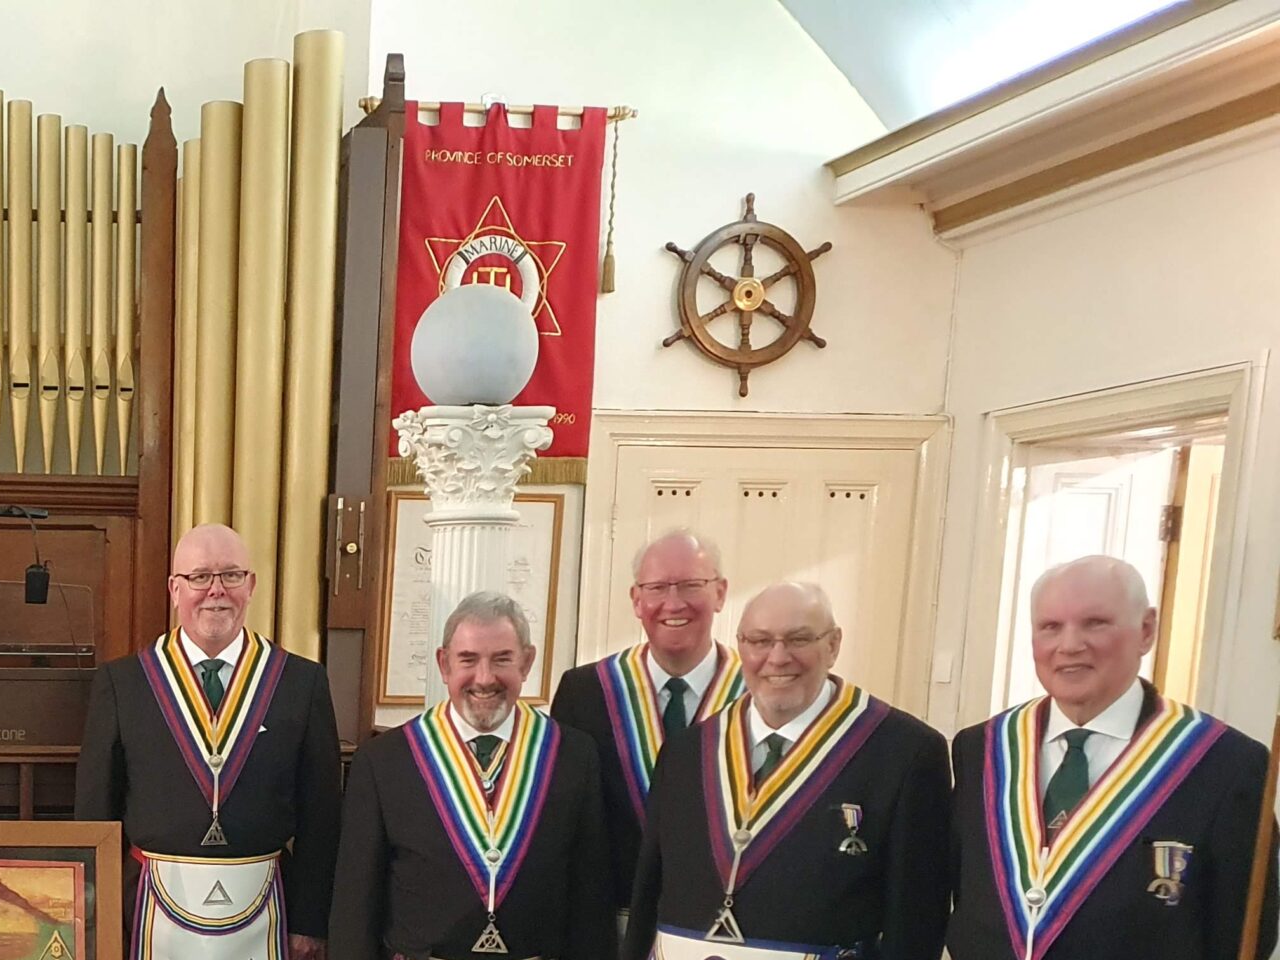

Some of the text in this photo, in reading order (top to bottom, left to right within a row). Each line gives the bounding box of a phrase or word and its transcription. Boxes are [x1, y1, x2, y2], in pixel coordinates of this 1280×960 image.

[425, 149, 574, 167] PROVINCE OF SOMERSET
[463, 236, 521, 260] MARINE
